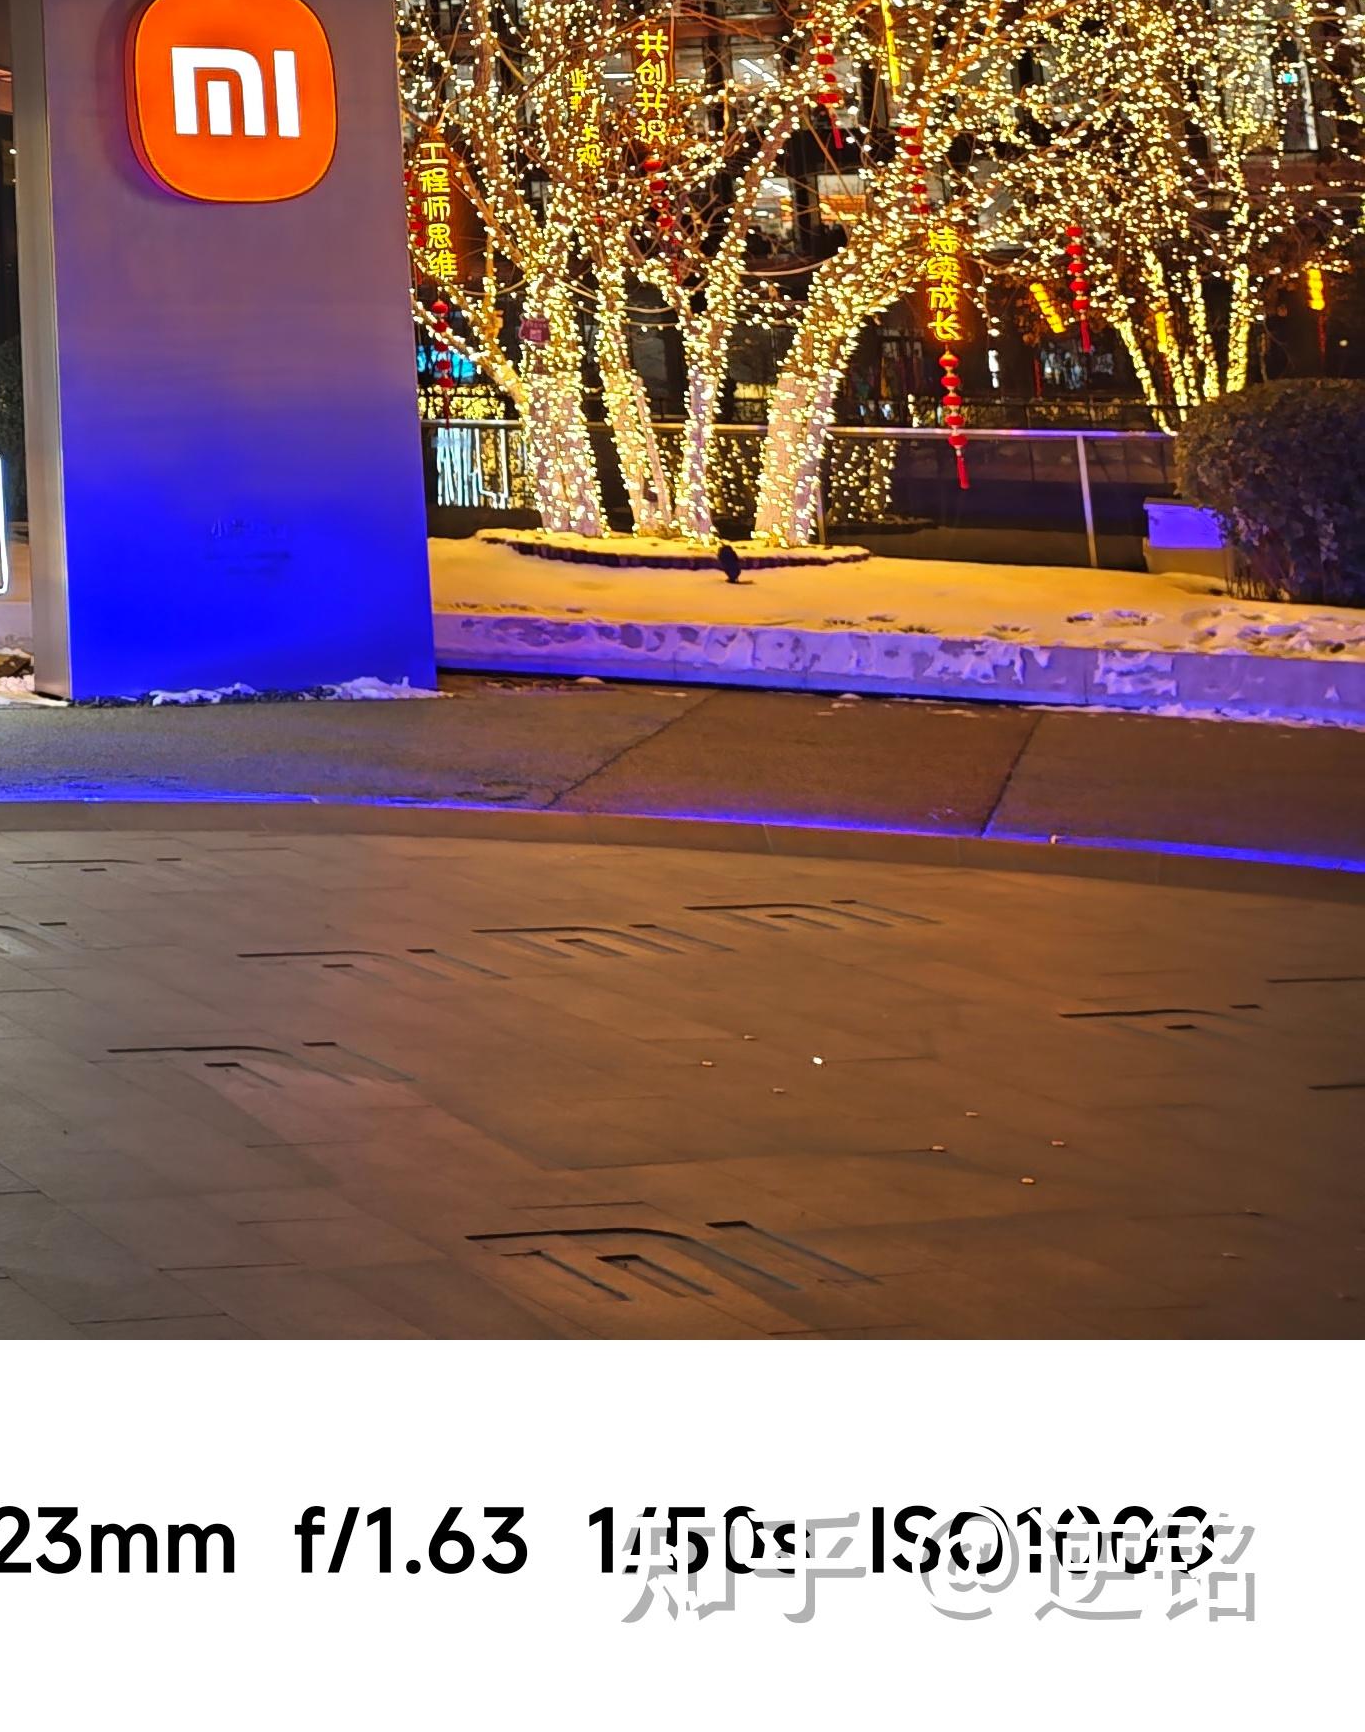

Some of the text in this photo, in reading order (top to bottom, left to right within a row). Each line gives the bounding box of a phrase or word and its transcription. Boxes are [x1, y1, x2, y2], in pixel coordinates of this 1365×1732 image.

[635, 29, 669, 146] 共创共识
[418, 142, 457, 279] 工程师思维
